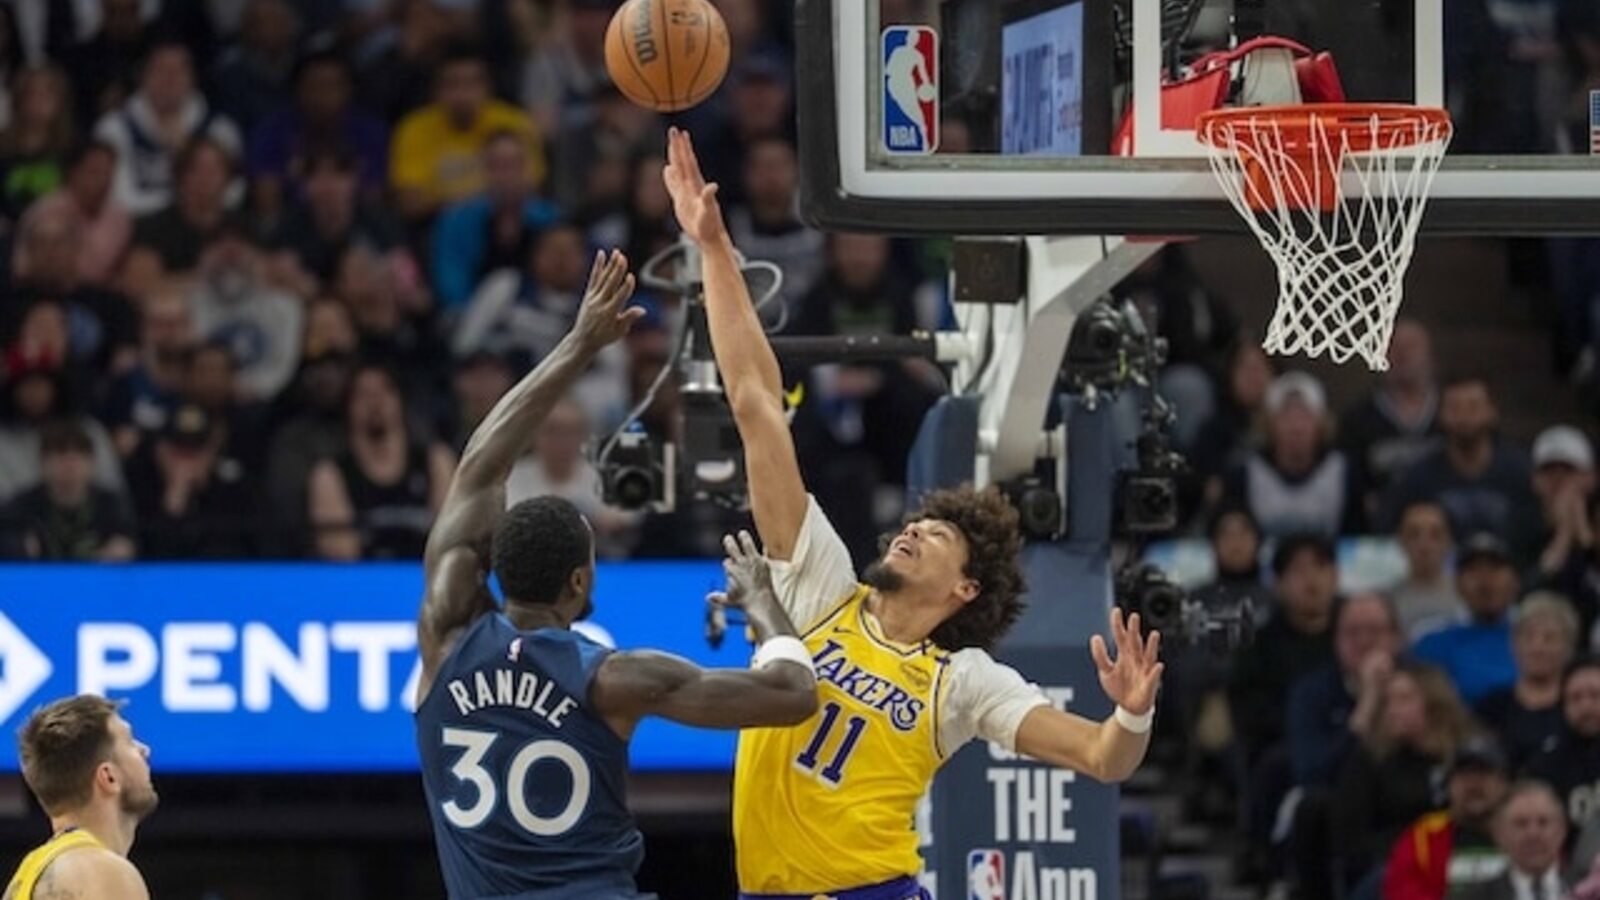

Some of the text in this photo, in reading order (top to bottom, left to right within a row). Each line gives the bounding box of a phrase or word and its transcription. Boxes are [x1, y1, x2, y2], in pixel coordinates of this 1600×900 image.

[888, 125, 918, 148] NBA
[448, 669, 578, 728] RANDLE
[795, 701, 867, 785] 11
[442, 727, 591, 836] 30
[987, 767, 1076, 843] THE
